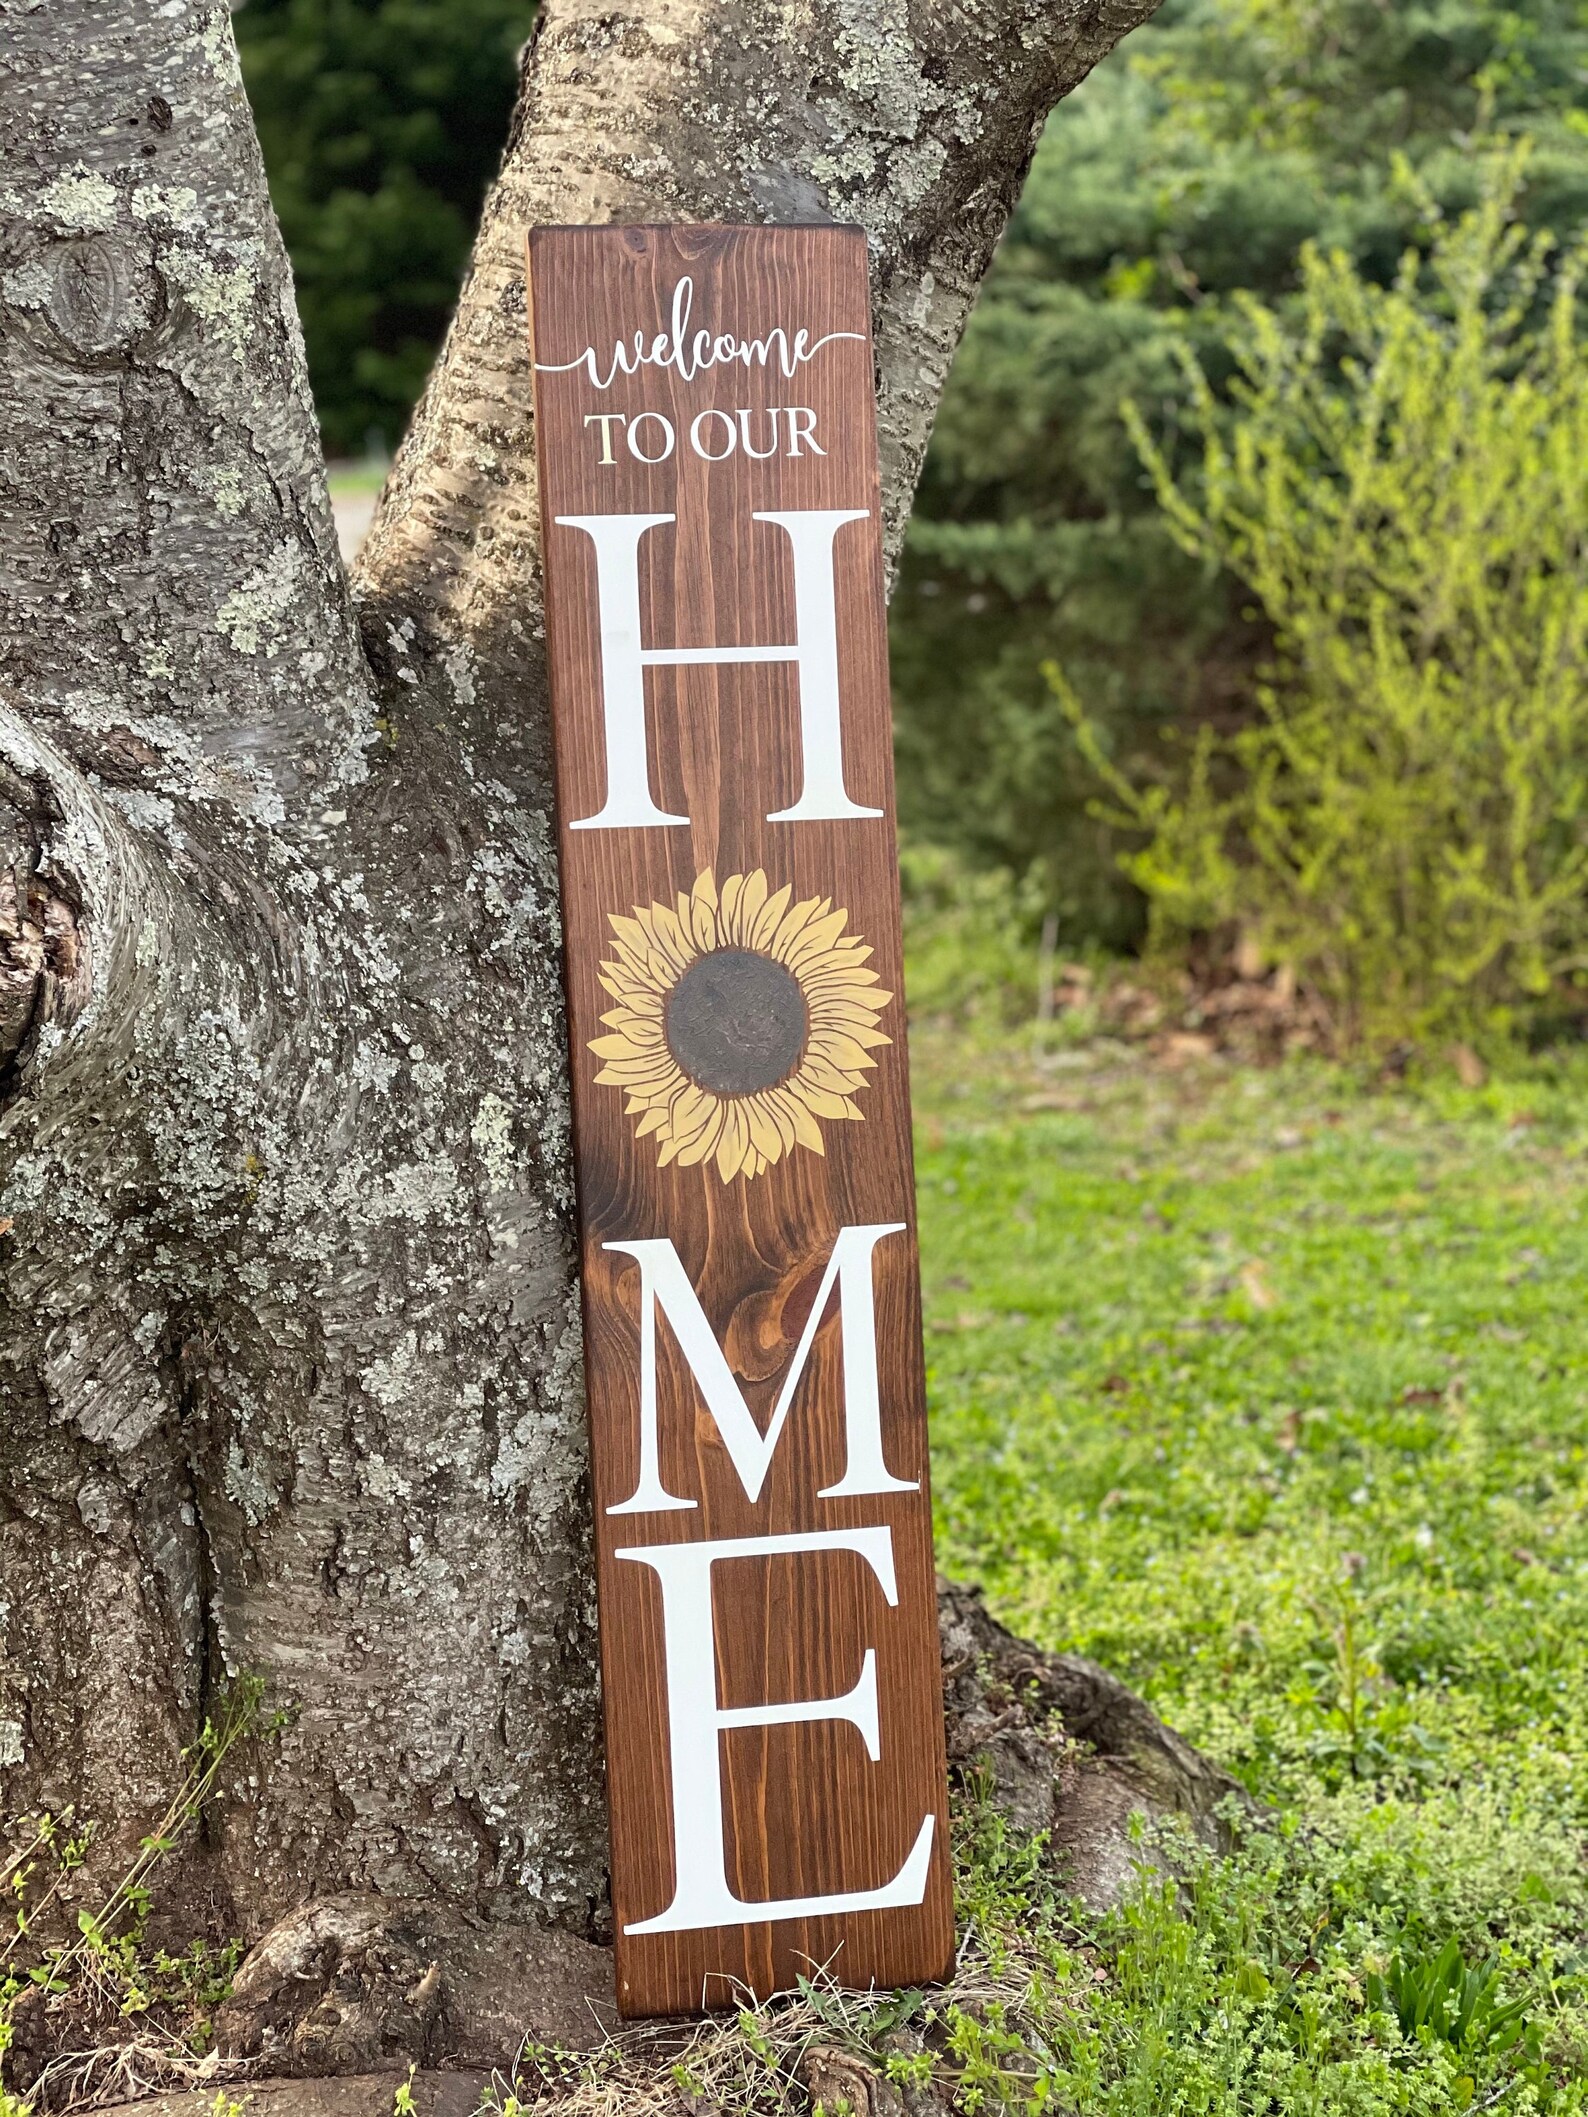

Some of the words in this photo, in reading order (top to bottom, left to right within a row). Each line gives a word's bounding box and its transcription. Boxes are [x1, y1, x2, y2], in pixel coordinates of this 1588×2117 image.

[534, 276, 866, 389] welcome
[584, 413, 675, 464] TO
[690, 407, 827, 461] OUR
